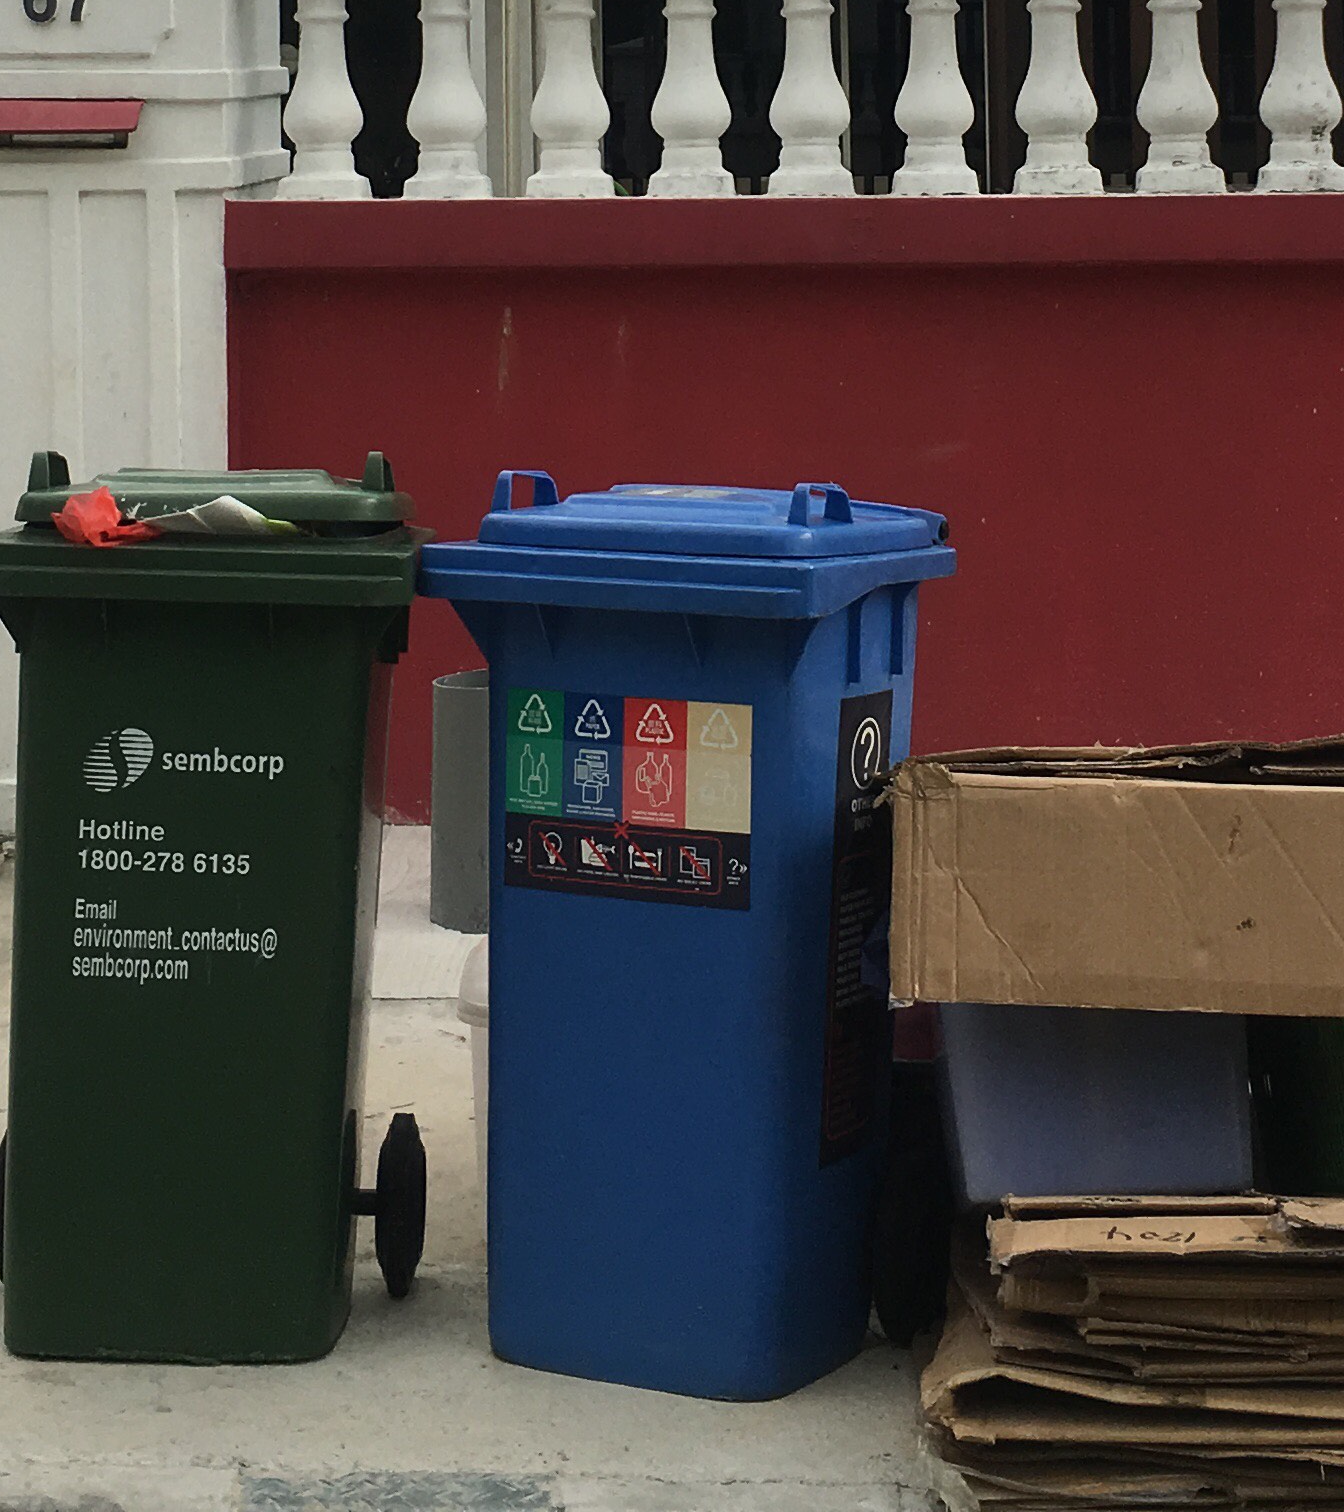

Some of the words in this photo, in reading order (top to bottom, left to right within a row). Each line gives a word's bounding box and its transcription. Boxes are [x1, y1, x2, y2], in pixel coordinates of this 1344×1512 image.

[162, 747, 283, 780] sembcorp
[79, 819, 164, 841] Hotline
[79, 850, 184, 872] 1800-278
[194, 854, 249, 874] 6135
[75, 898, 116, 919] Email
[74, 924, 277, 958] environment_contactus@
[73, 953, 188, 985] sembcorp.com
